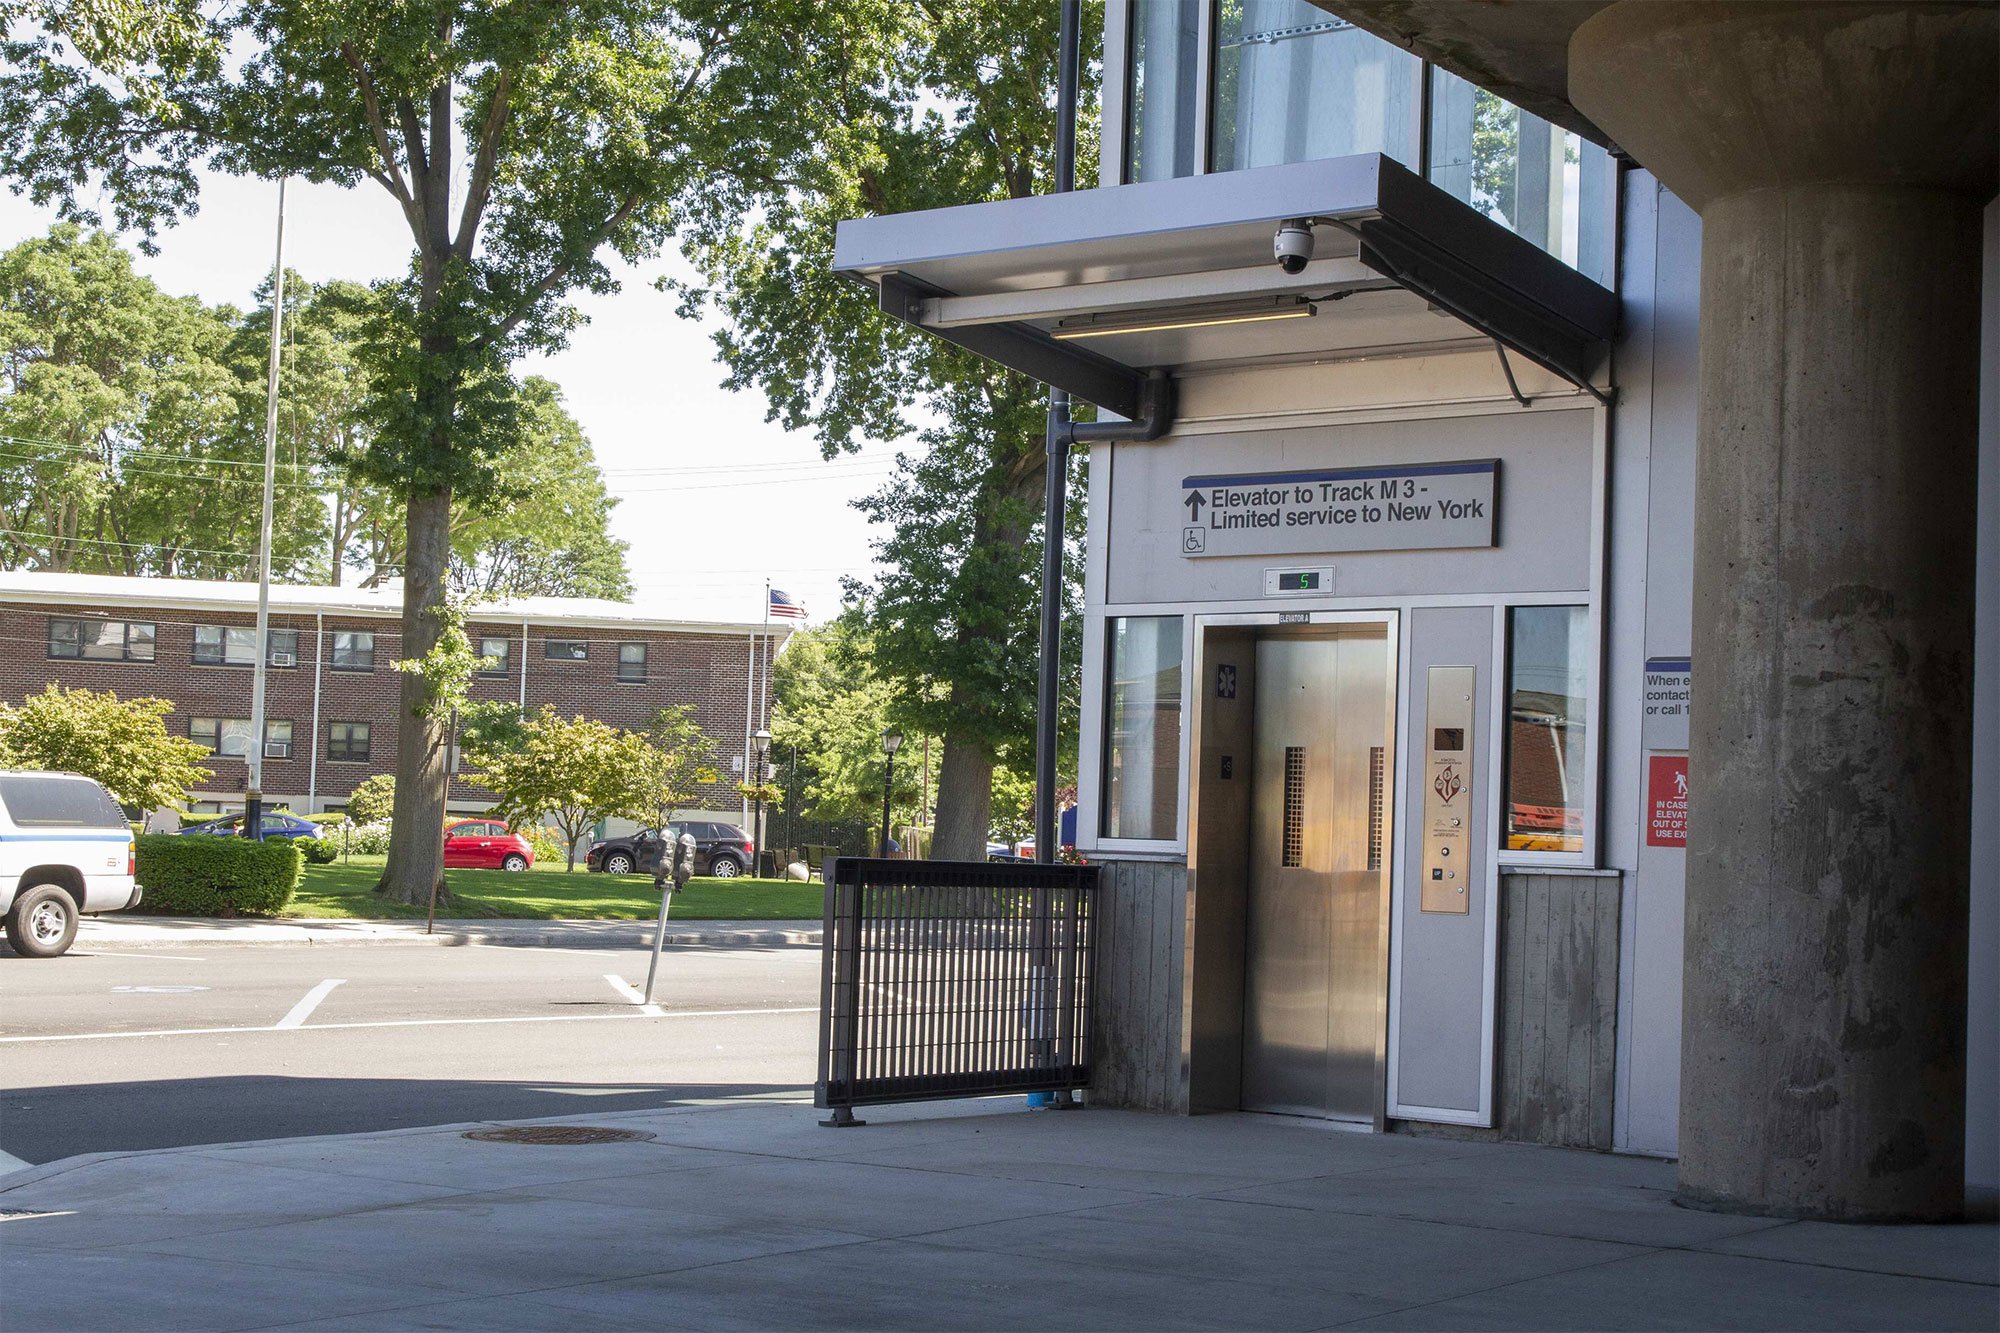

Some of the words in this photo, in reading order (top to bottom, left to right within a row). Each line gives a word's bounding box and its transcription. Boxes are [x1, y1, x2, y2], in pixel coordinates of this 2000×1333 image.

[1212, 488, 1289, 508] Elevator
[1294, 486, 1313, 504] to
[1319, 481, 1374, 503] Track
[1380, 480, 1397, 499] M
[1403, 479, 1415, 499] 3
[1211, 508, 1280, 530] Limited
[1286, 506, 1357, 527] service
[1361, 505, 1381, 523] to
[1387, 502, 1432, 522] New
[1437, 498, 1484, 520] York
[1280, 614, 1304, 623] ELEVATOR
[1647, 675, 1680, 686] When
[1646, 690, 1690, 700] contact
[1646, 706, 1659, 715] or
[1661, 704, 1681, 715] call
[1656, 800, 1665, 808] IN
[1666, 801, 1688, 809] CASE
[1656, 810, 1687, 819] ELEVAT
[1652, 820, 1670, 828] OUT
[1671, 820, 1683, 828] OF
[1656, 829, 1673, 838] USE
